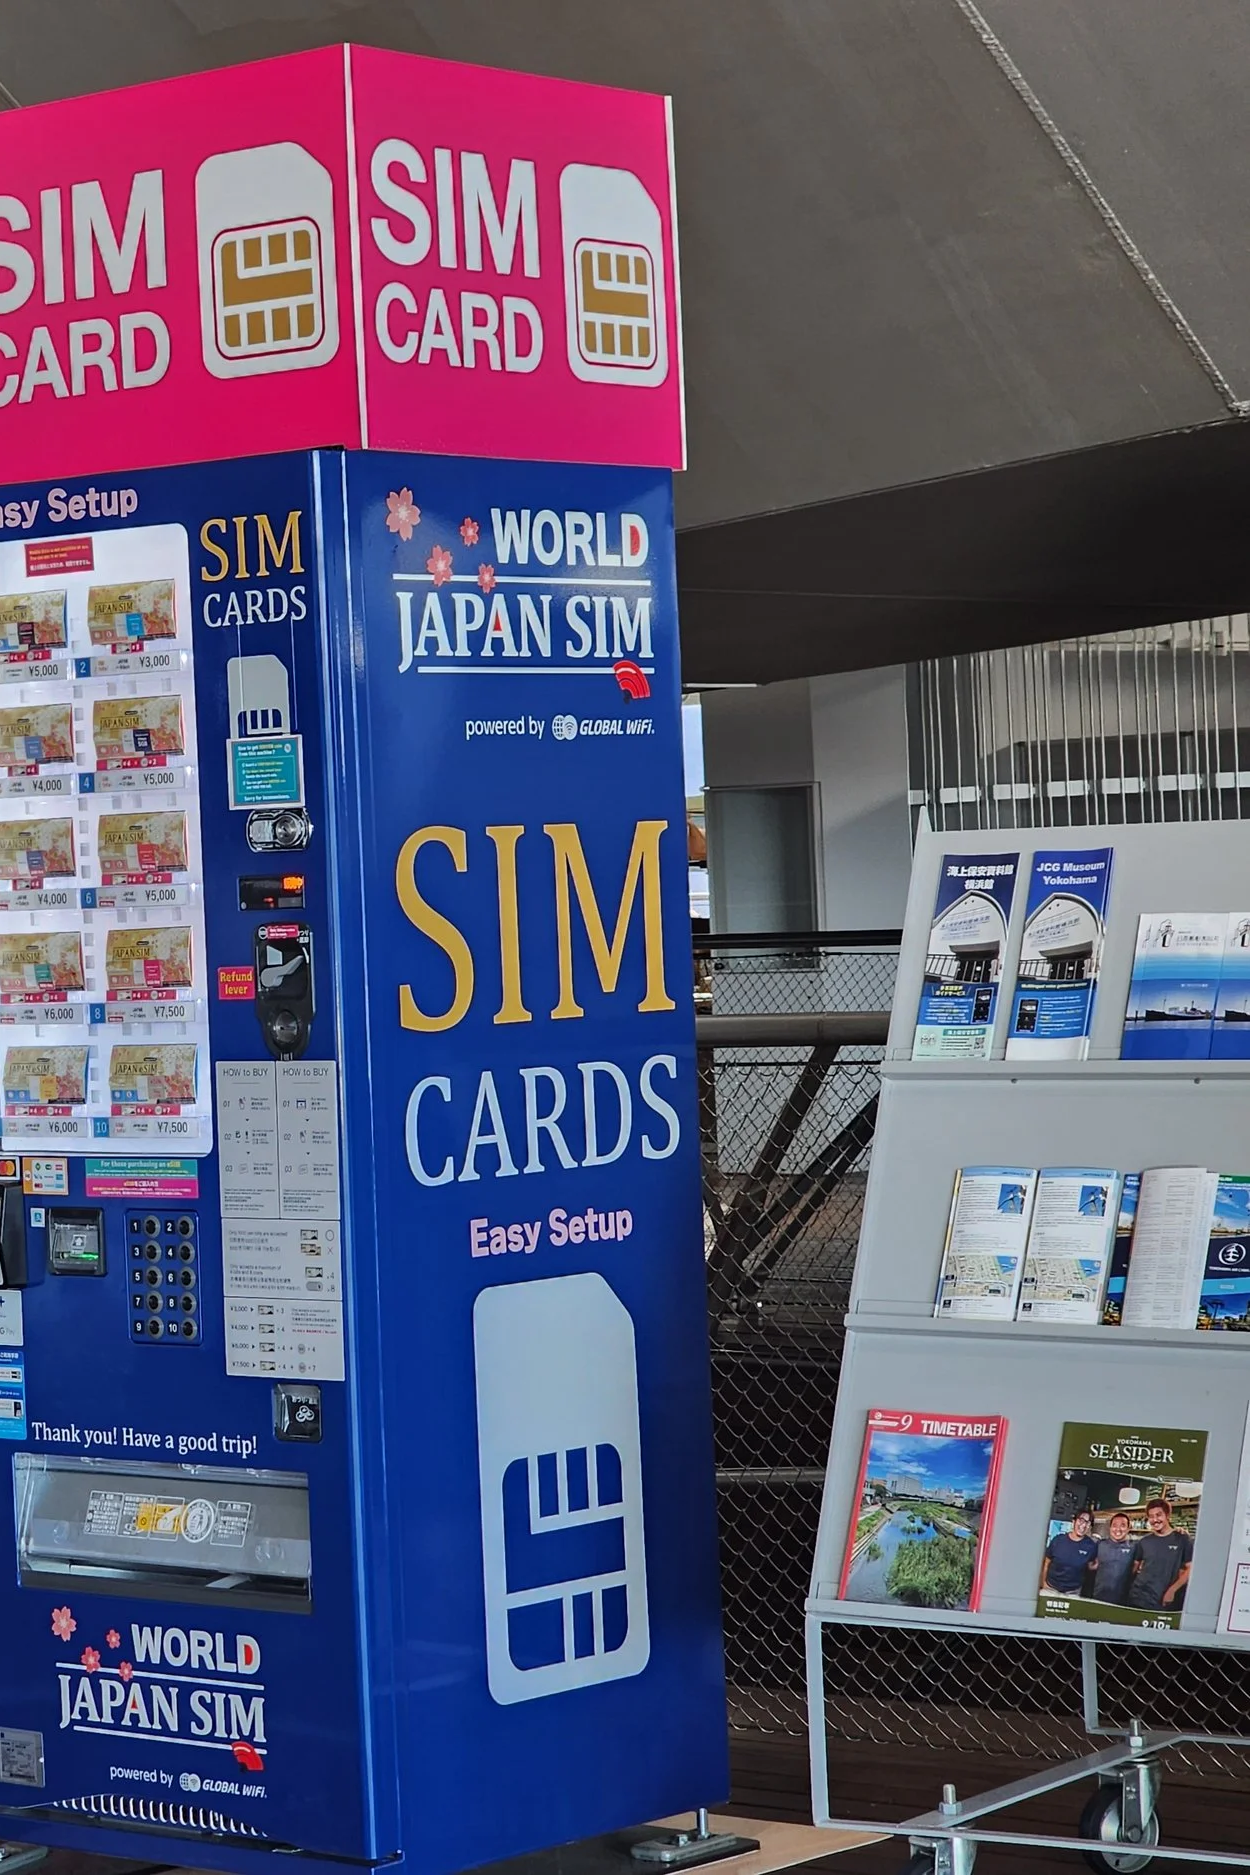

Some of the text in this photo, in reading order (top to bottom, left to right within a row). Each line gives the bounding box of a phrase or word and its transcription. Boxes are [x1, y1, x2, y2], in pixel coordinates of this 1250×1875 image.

[370, 138, 539, 279] SIM
[375, 282, 543, 374] CARD
[48, 486, 138, 522] Setup
[490, 508, 649, 567] WORLD
[199, 511, 304, 582] SIM
[203, 586, 307, 627] CARDS
[396, 592, 654, 674] JAPAN SIM
[29, 664, 58, 676] ¥5,000
[80, 662, 86, 673] 2
[139, 655, 170, 667] ¥3,000
[465, 716, 527, 740] powered
[529, 718, 545, 740] by
[579, 719, 624, 736] GLOBAL
[33, 780, 62, 791] ¥4,000
[83, 773, 174, 788] 4 ¥5,000
[947, 864, 1014, 877] 海上保安資料館
[1036, 861, 1105, 872] JCG Museum
[965, 879, 994, 890] 横浜館
[1043, 875, 1097, 885] Yokohama
[38, 894, 67, 904] ¥4,000
[86, 890, 176, 903] 6 ¥5,000
[395, 819, 676, 1032] SIM
[220, 972, 252, 982] Refund
[225, 984, 248, 994] lever
[44, 1008, 74, 1019] ¥6,000
[95, 1006, 185, 1018] 8 ¥7,500
[223, 1069, 241, 1077] HOW
[253, 1068, 267, 1076] BUY
[303, 1068, 310, 1076] to
[313, 1068, 328, 1076] BUY
[404, 1053, 681, 1187] CARDS
[49, 1122, 78, 1133] ¥6,000
[97, 1121, 188, 1133] 10 ¥7,500
[469, 1207, 633, 1257] Easy Setup
[134, 1248, 173, 1256] 3 4
[135, 1273, 173, 1282] 5 6
[135, 1298, 174, 1307] 7 8
[136, 1323, 177, 1333] 9 10
[899, 1414, 996, 1436] 9 TIMETABLE
[31, 1422, 258, 1458] Thank you! Have a good trip!
[1089, 1444, 1174, 1463] SEASIDER
[131, 1624, 260, 1674] WORLD
[58, 1674, 267, 1743] JAPAN SIM
[110, 1766, 157, 1784] powered
[160, 1771, 173, 1787] by
[202, 1779, 240, 1795] GLOBAL
